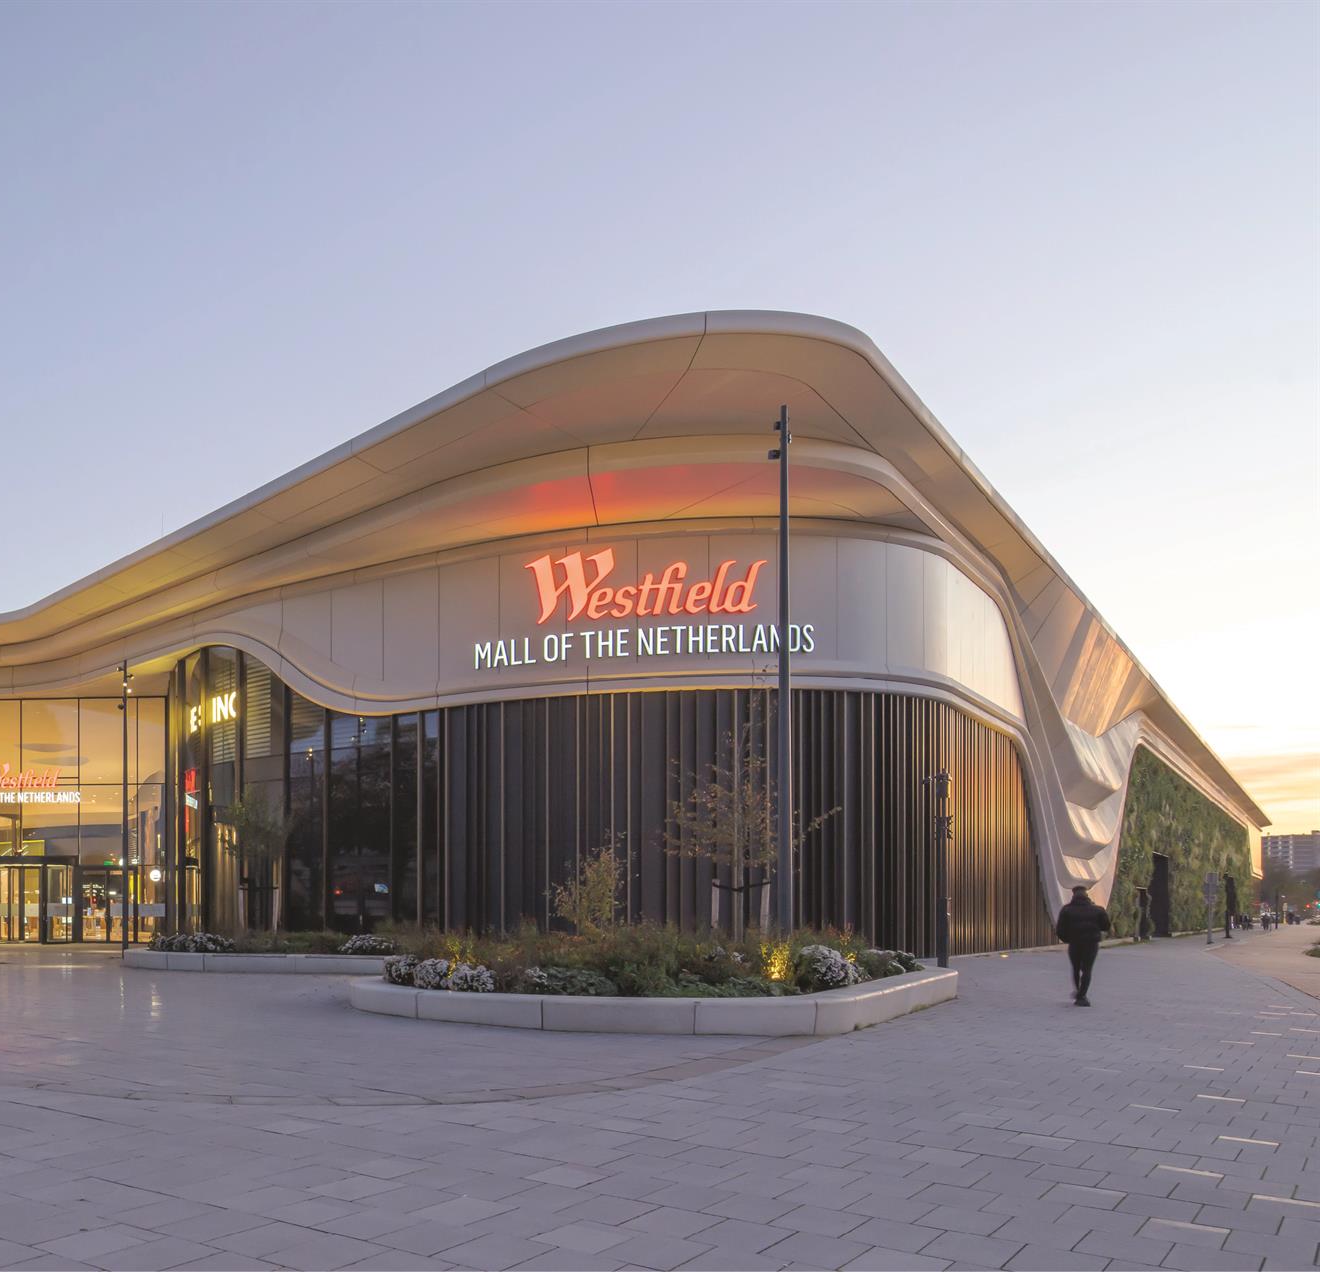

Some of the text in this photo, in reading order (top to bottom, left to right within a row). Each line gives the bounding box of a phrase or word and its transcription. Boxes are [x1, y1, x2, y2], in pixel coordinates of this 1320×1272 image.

[524, 547, 768, 625] Westfield
[474, 624, 815, 670] MALL OF THE NETHERLANDS
[0, 791, 15, 804] THE
[17, 791, 81, 804] NETHERLANDS
